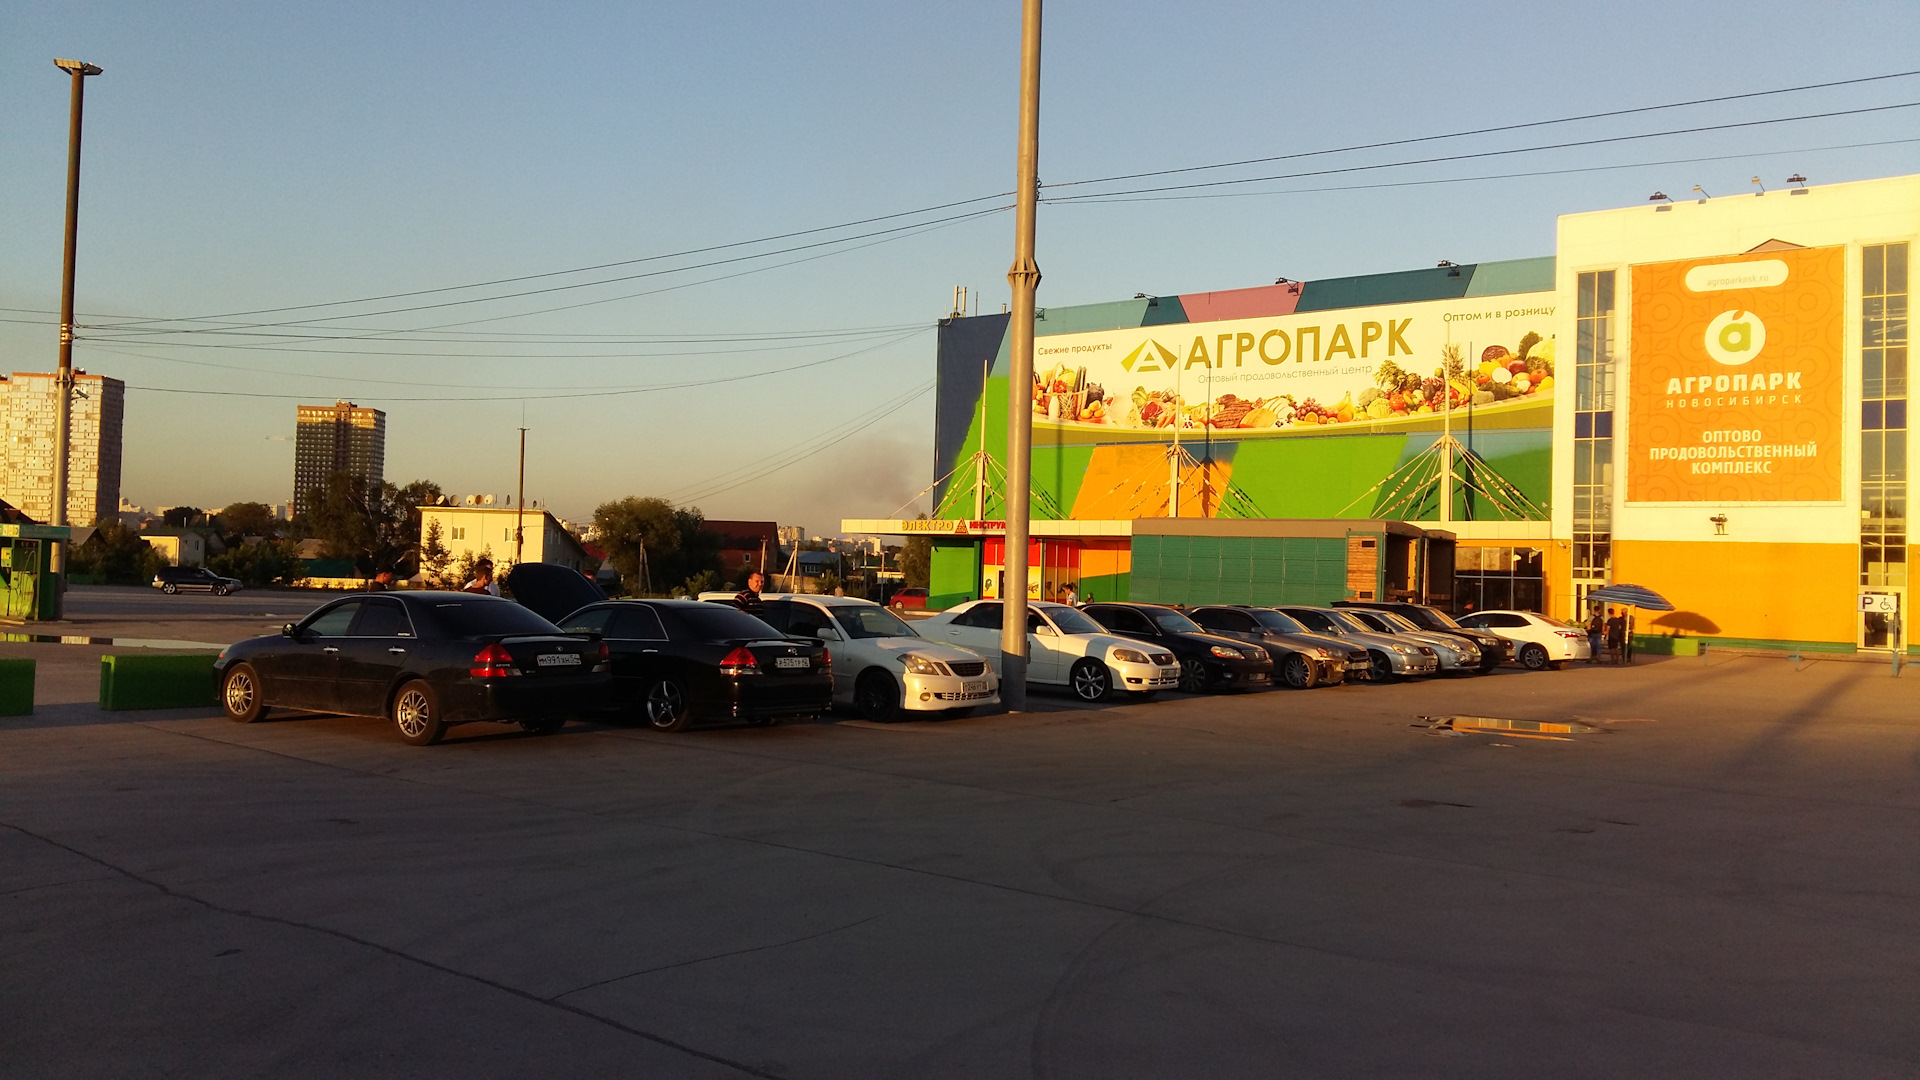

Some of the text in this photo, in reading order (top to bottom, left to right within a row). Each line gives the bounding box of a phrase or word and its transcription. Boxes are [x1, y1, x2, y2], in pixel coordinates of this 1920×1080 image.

[1443, 306, 1556, 322] Оптом и в розницу
[1038, 343, 1112, 355] Свежие продукты
[1184, 318, 1414, 370] АГРОПАРК
[1198, 365, 1373, 384] Оптовый продовольственный центр
[1666, 372, 1802, 395] АГРОПАРК
[1666, 394, 1802, 409] НОВОСИБИРСК
[1703, 429, 1762, 443] ОПТОВО
[1650, 441, 1817, 461] ПРОДОВОЛЬСТВЕННЫЙ
[1692, 461, 1772, 474] КОМПЛЕКС
[902, 520, 954, 531] ЭЛЕКТРО
[1862, 596, 1874, 610] P
